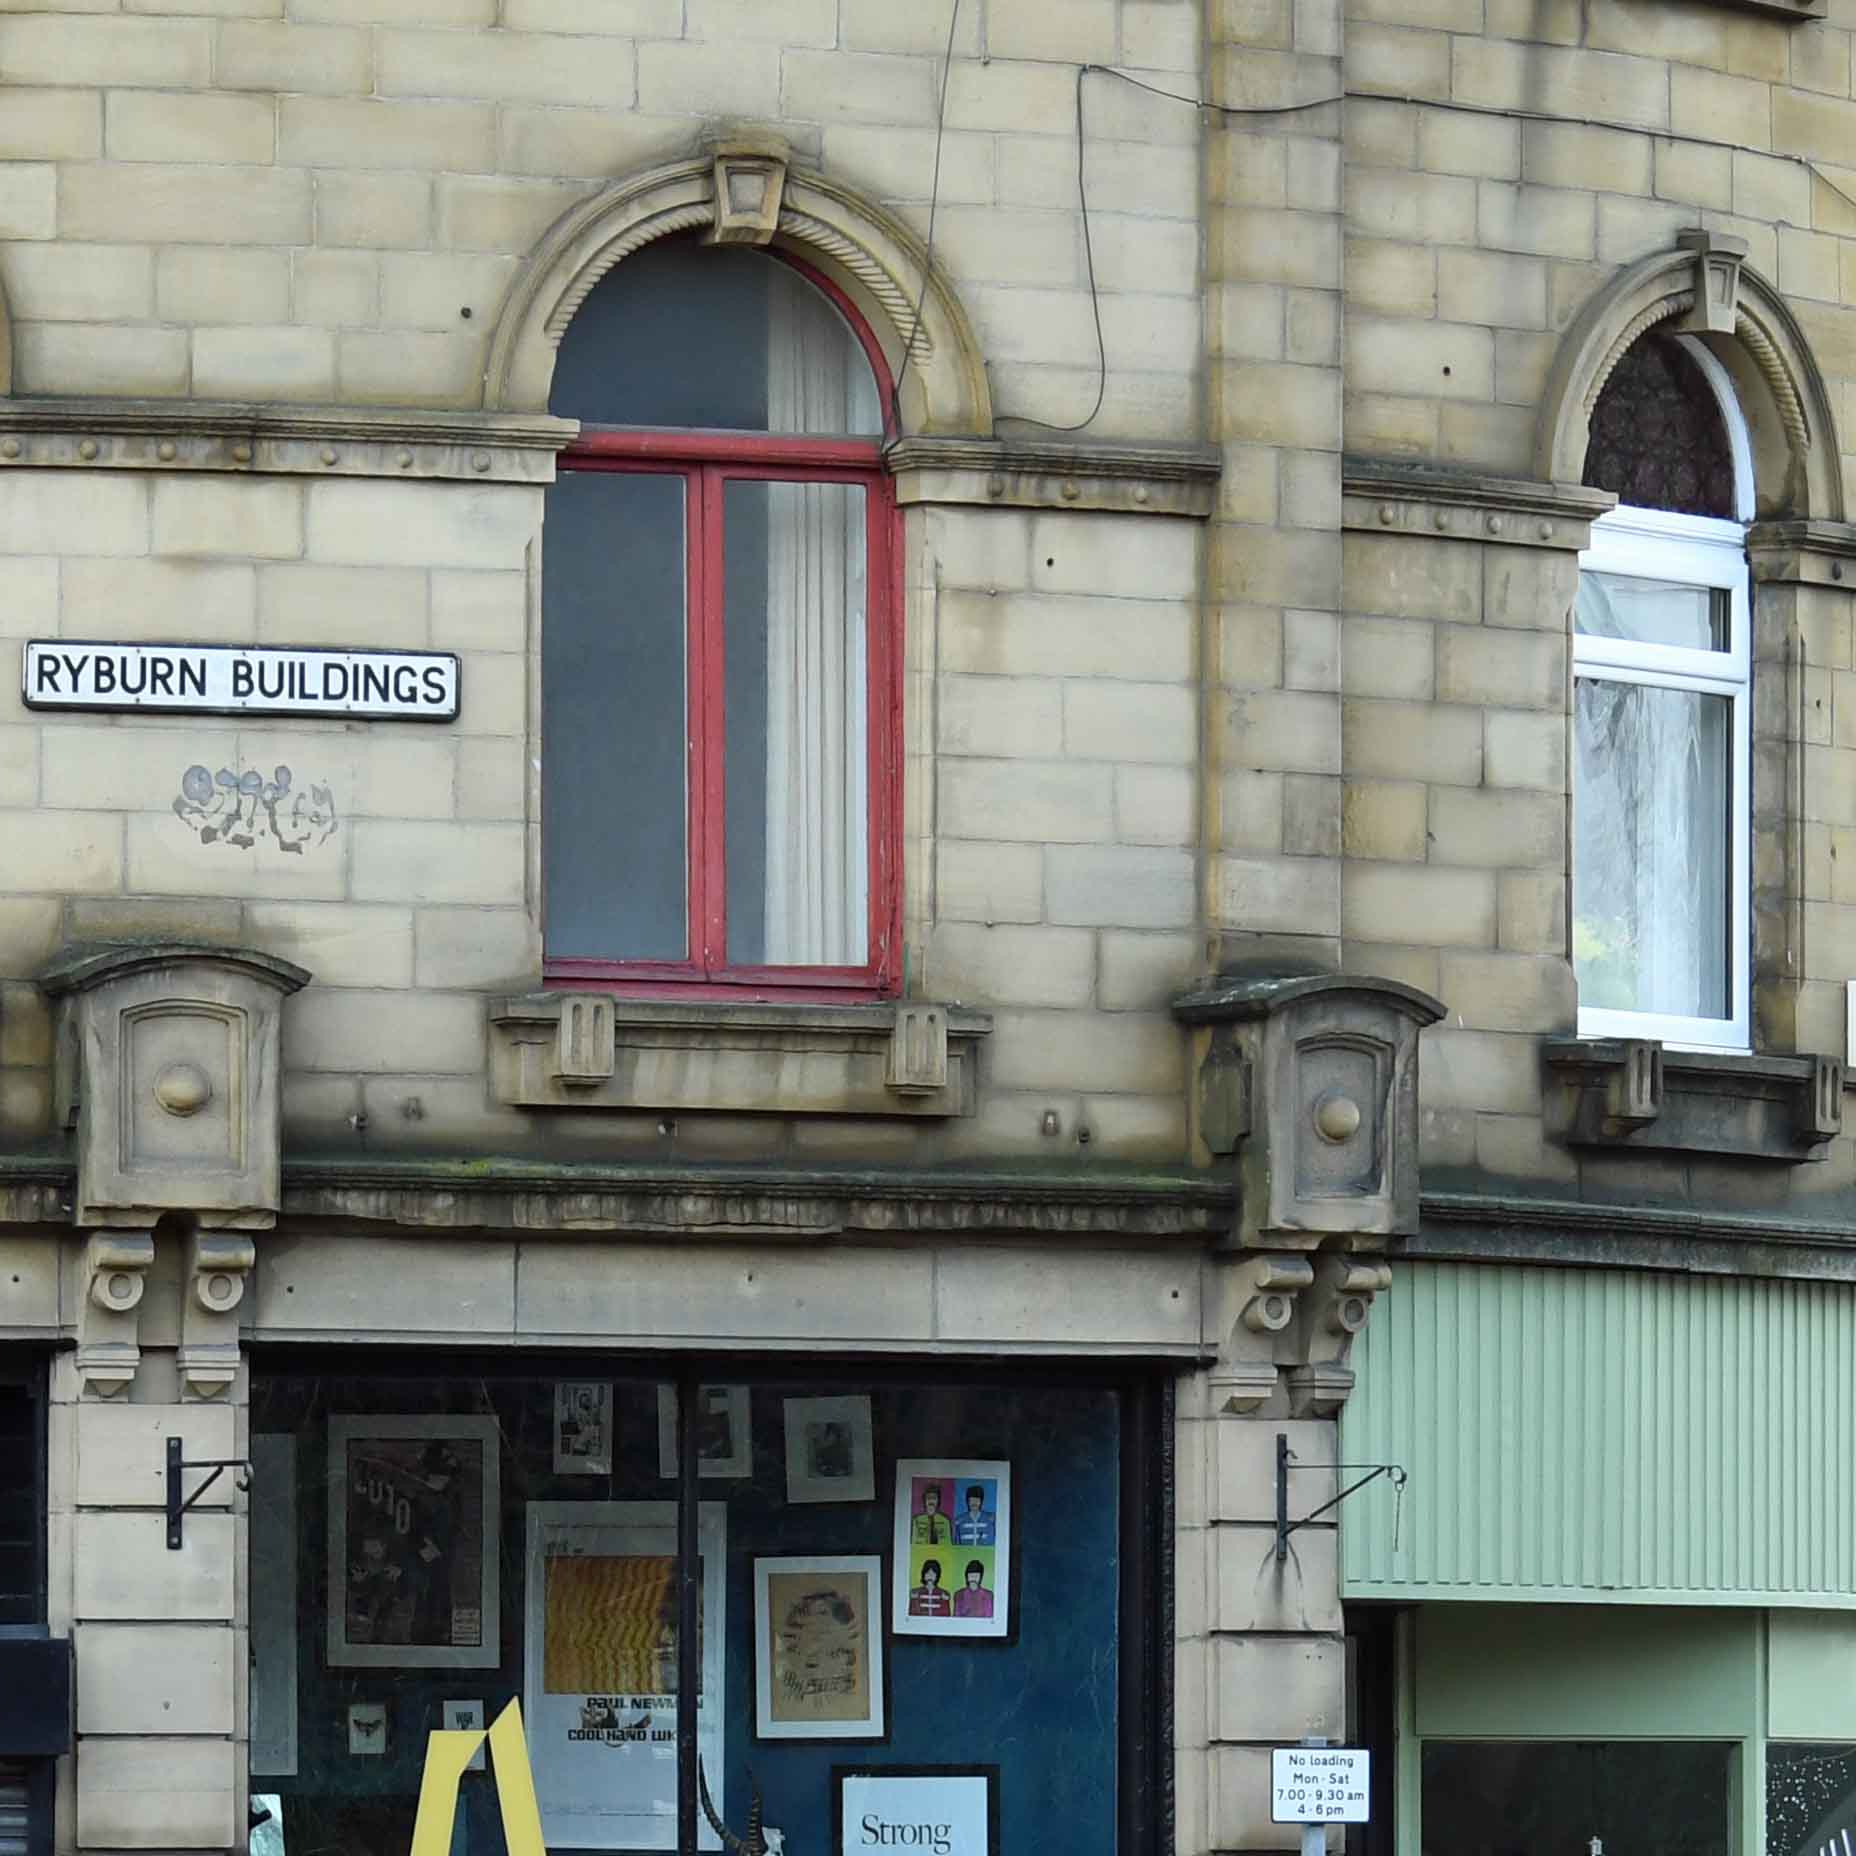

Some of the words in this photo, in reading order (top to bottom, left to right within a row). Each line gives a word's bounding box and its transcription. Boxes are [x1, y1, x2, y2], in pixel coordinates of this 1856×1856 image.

[36, 653, 207, 697] RYBURN
[231, 659, 447, 705] BUILDINGS
[1289, 1754, 1305, 1766] No
[1310, 1754, 1354, 1768] loading
[1293, 1772, 1318, 1784] Mon
[1328, 1772, 1350, 1785] Sat
[1277, 1788, 1306, 1801] 7.00
[1315, 1788, 1344, 1801] 9.30
[1347, 1791, 1365, 1801] am
[1297, 1803, 1305, 1814] 4
[1315, 1803, 1323, 1815] 6
[1326, 1805, 1345, 1816] pm
[861, 1814, 952, 1855] Strong
